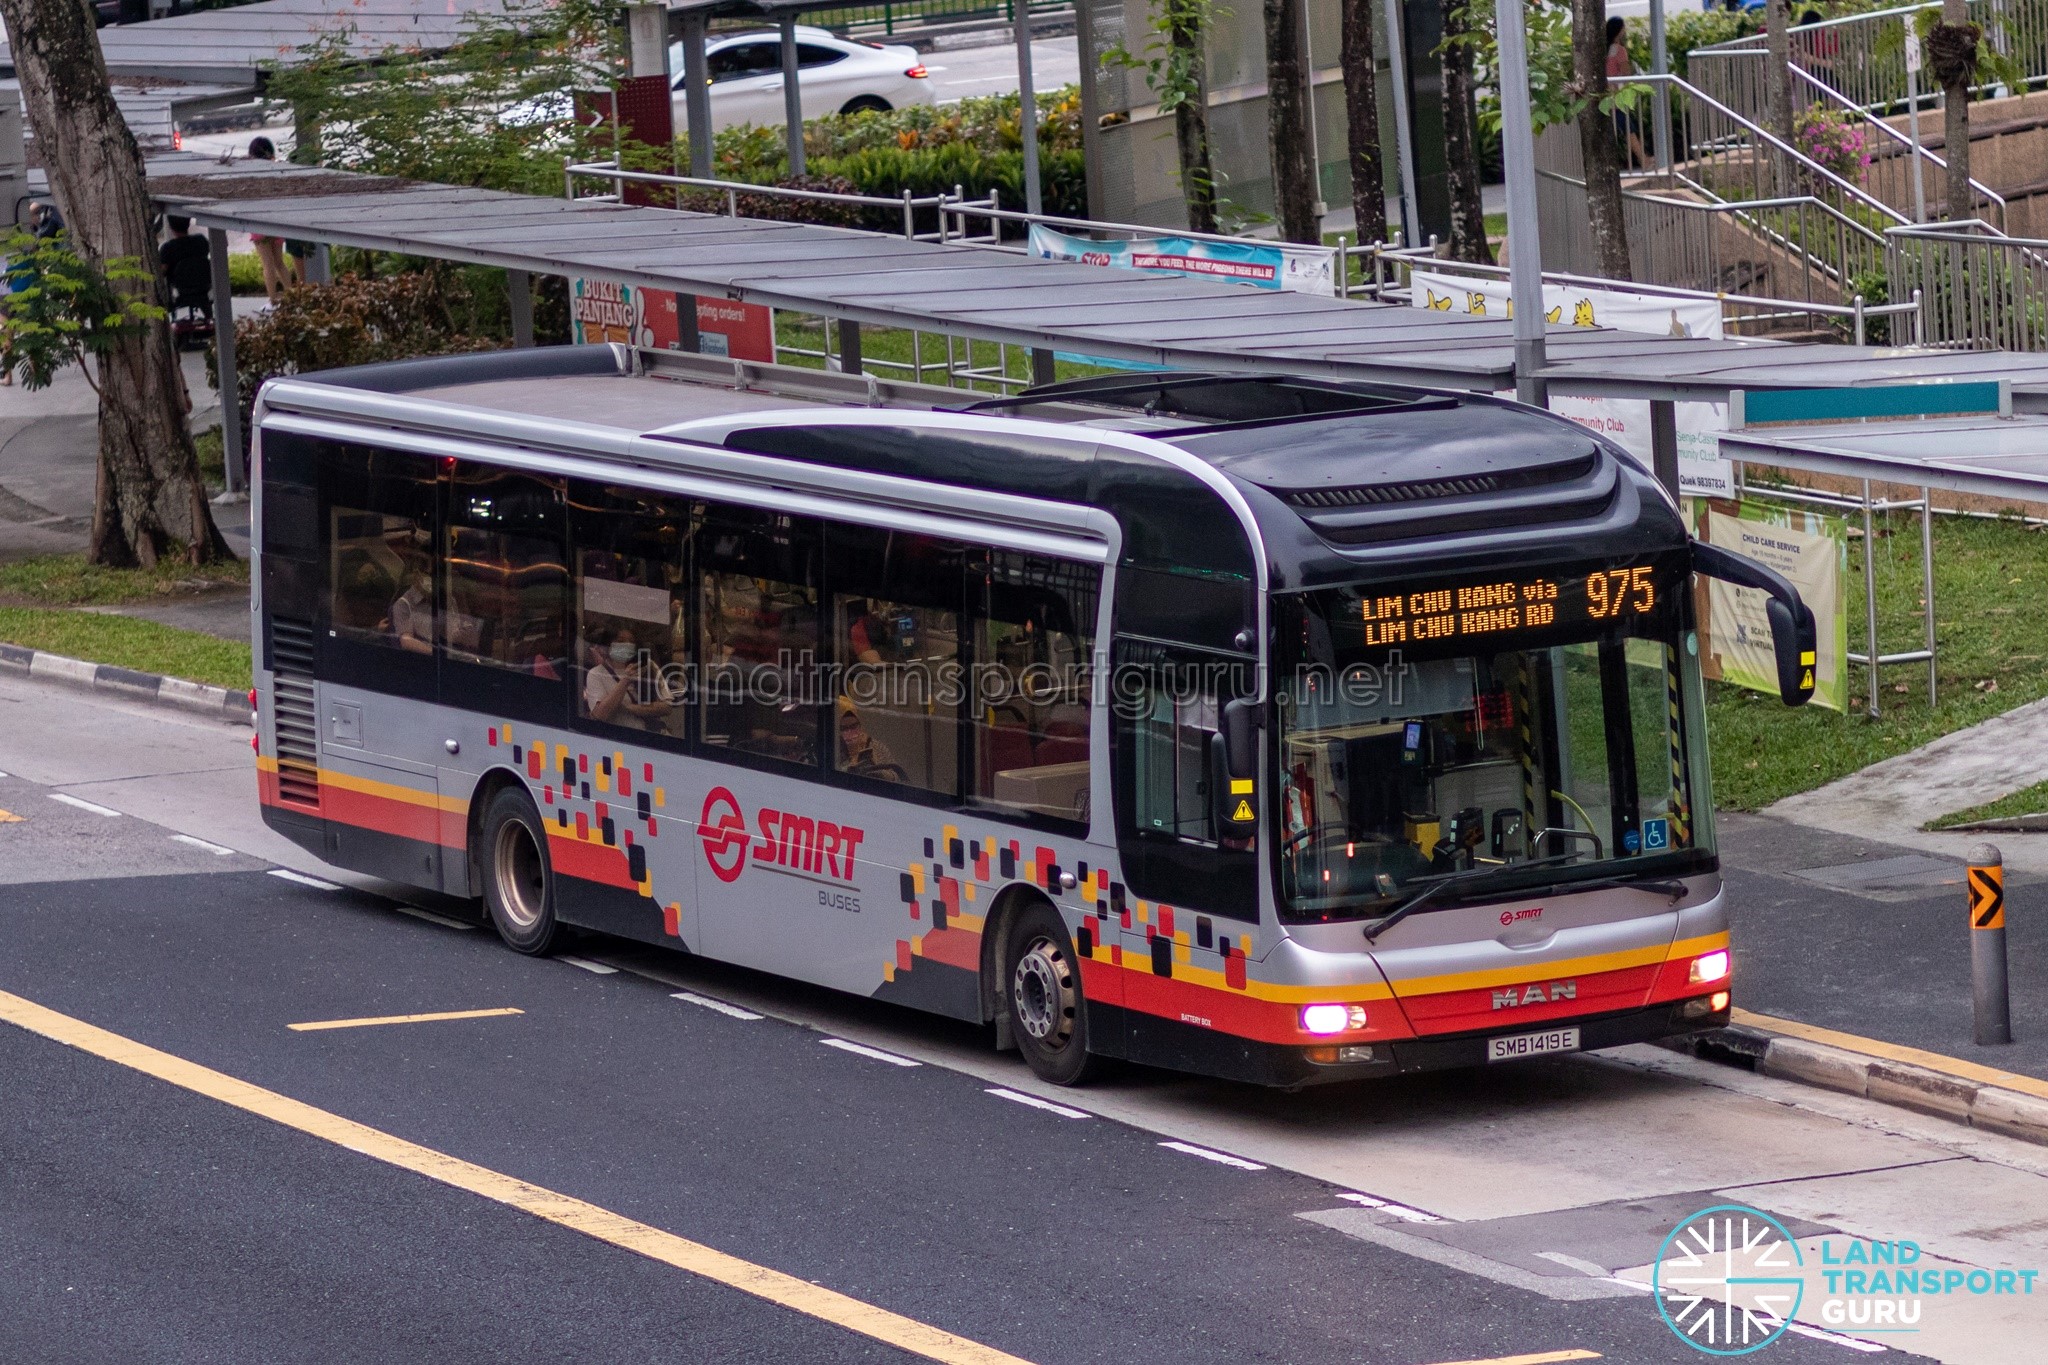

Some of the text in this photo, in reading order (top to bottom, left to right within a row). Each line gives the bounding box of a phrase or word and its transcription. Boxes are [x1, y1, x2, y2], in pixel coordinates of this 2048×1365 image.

[1195, 260, 1212, 271] MORE
[1211, 262, 1235, 274] PIGEONS
[1235, 265, 1251, 276] THERE
[1252, 267, 1264, 277] WILL
[1265, 268, 1273, 278] BE
[583, 278, 623, 300] BUKIT
[575, 299, 634, 328] PANJANG
[665, 298, 678, 313] No
[718, 305, 746, 322] orders!
[1606, 417, 1625, 433] Club
[1679, 474, 1726, 489] Quek 98397834
[1742, 533, 1801, 554] CHILD CARE SERVICE
[1362, 578, 1558, 621] LIM CHU KANG via
[1586, 565, 1655, 618] 975
[1366, 603, 1555, 645] LIM CHU KANG RD
[752, 807, 865, 881] SMRT
[818, 890, 861, 913] BUSES
[1514, 907, 1544, 921] SMRT
[1491, 979, 1577, 1010] MAN
[1180, 1012, 1212, 1027] BATTERY BOX
[1495, 1032, 1573, 1057] SMB1419E
